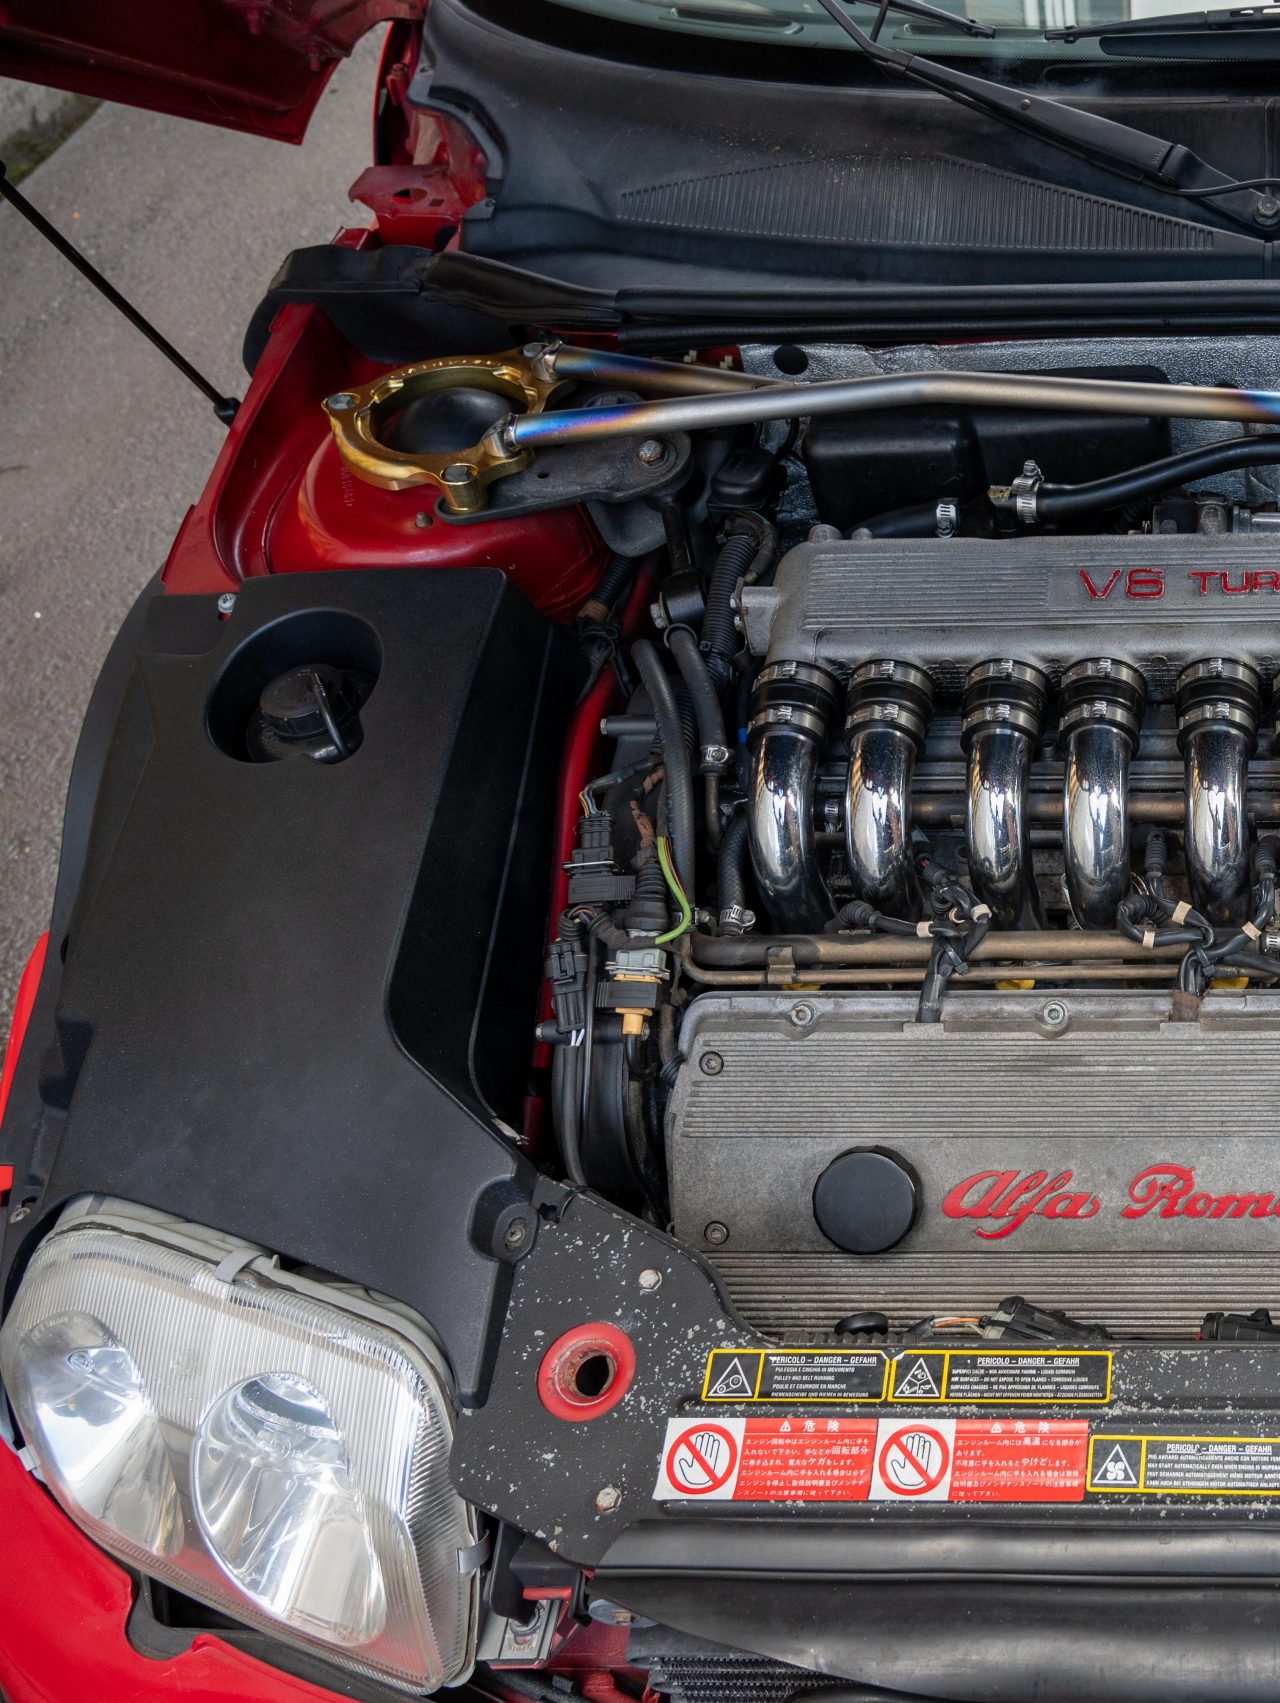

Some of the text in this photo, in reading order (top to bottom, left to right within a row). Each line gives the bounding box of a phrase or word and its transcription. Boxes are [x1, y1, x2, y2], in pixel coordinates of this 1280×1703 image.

[1078, 568, 1165, 599] V6
[942, 1170, 1100, 1240] Alfa
[814, 1356, 842, 1364] DANGER
[850, 1356, 878, 1364] GEFAHR
[803, 1420, 839, 1432] 危険
[1015, 1421, 1049, 1433] 危険
[1208, 1444, 1237, 1452] DANGER
[1245, 1445, 1273, 1453] GEFAHR
